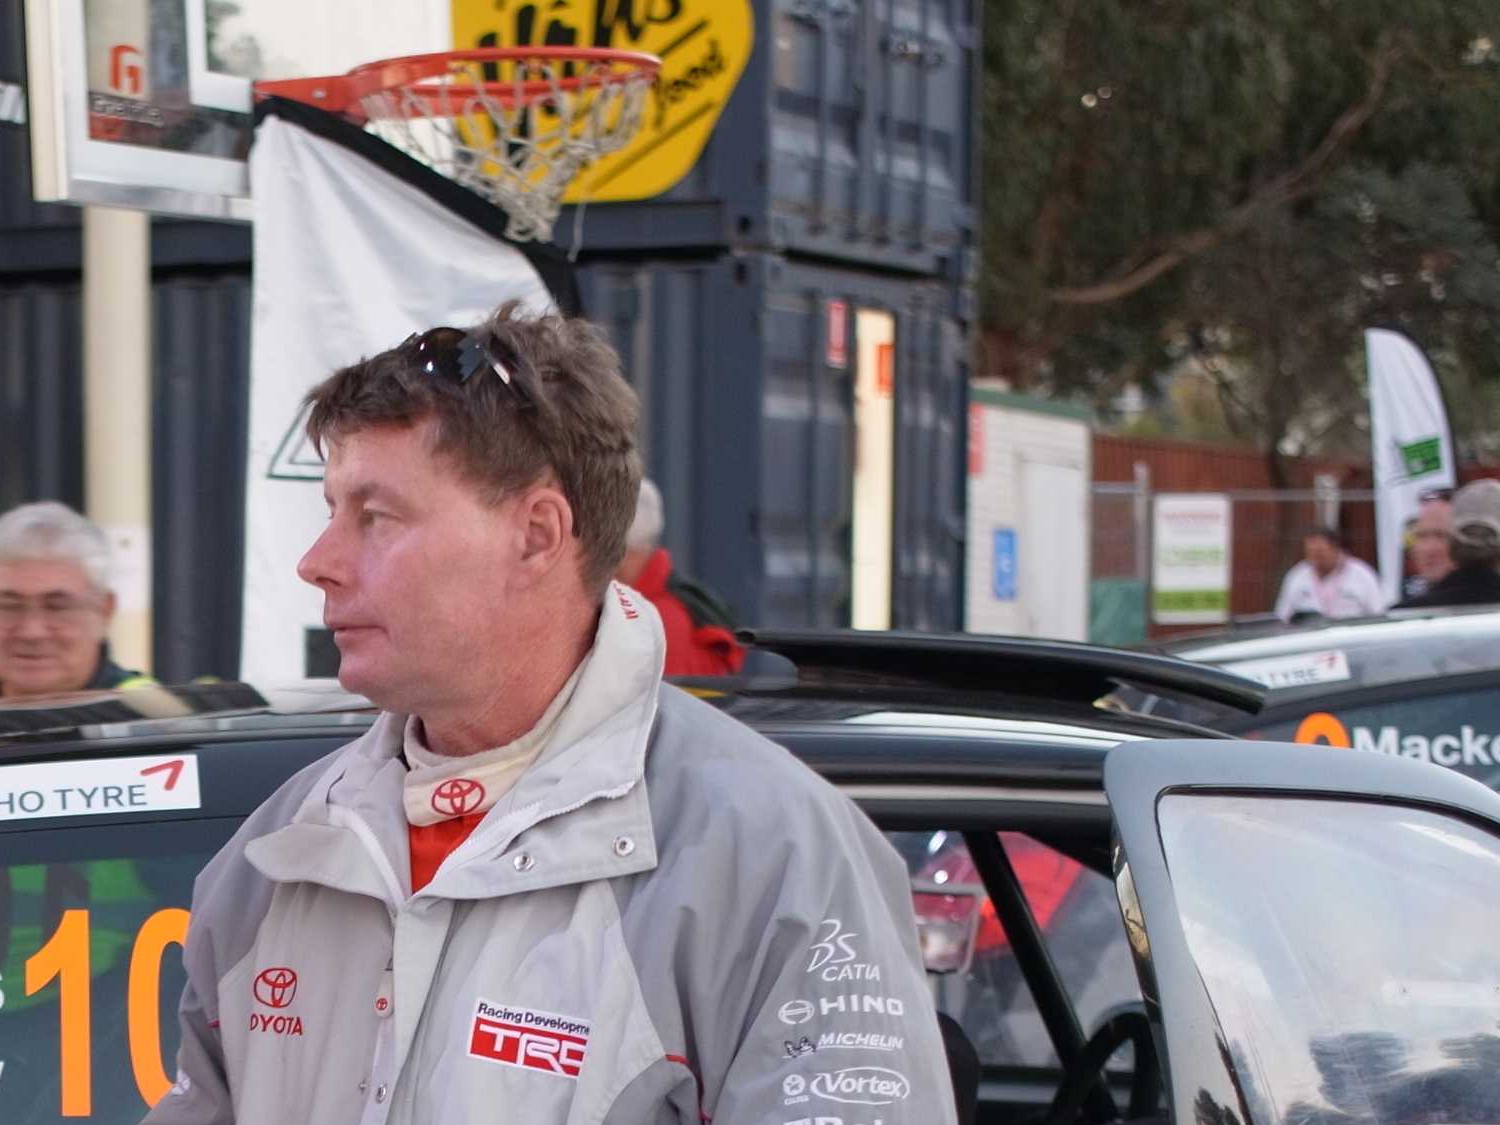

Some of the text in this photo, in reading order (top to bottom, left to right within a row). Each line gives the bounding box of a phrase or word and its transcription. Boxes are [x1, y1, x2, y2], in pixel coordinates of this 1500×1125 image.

[53, 784, 148, 811] TYRE
[821, 963, 881, 982] CATIA
[820, 994, 905, 1017] HINO
[478, 1002, 591, 1037] Racing Developme
[818, 1032, 905, 1050] MICHELIN
[814, 1072, 903, 1098] Vortex
